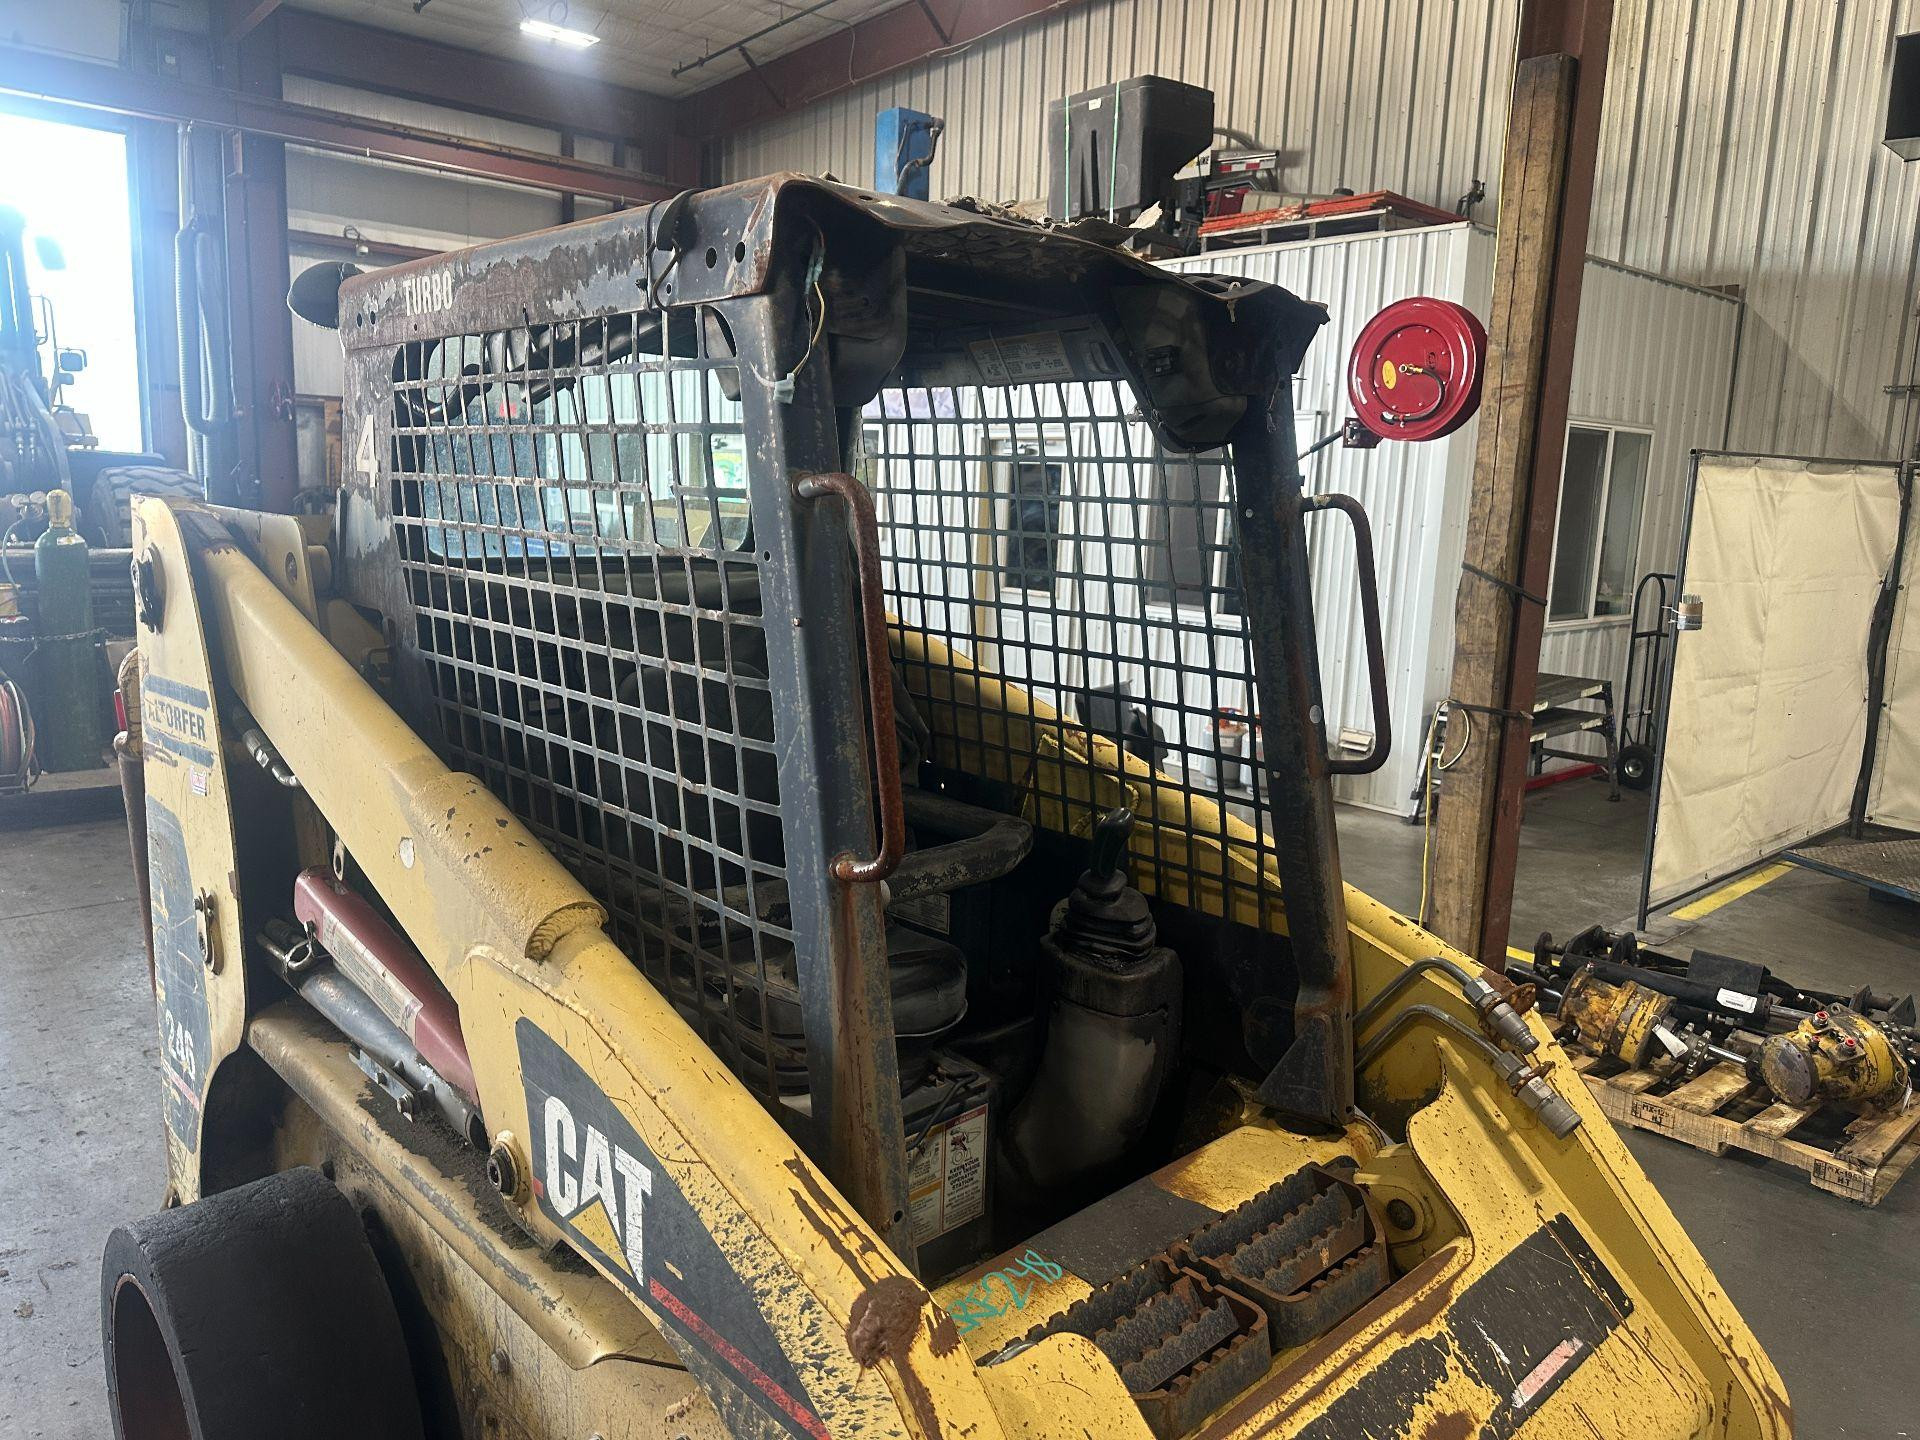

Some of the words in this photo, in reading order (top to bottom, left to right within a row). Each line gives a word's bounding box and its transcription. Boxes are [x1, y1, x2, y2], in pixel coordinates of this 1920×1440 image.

[403, 270, 453, 317] TURBO
[356, 414, 378, 488] 4
[544, 1095, 652, 1287] CAT
